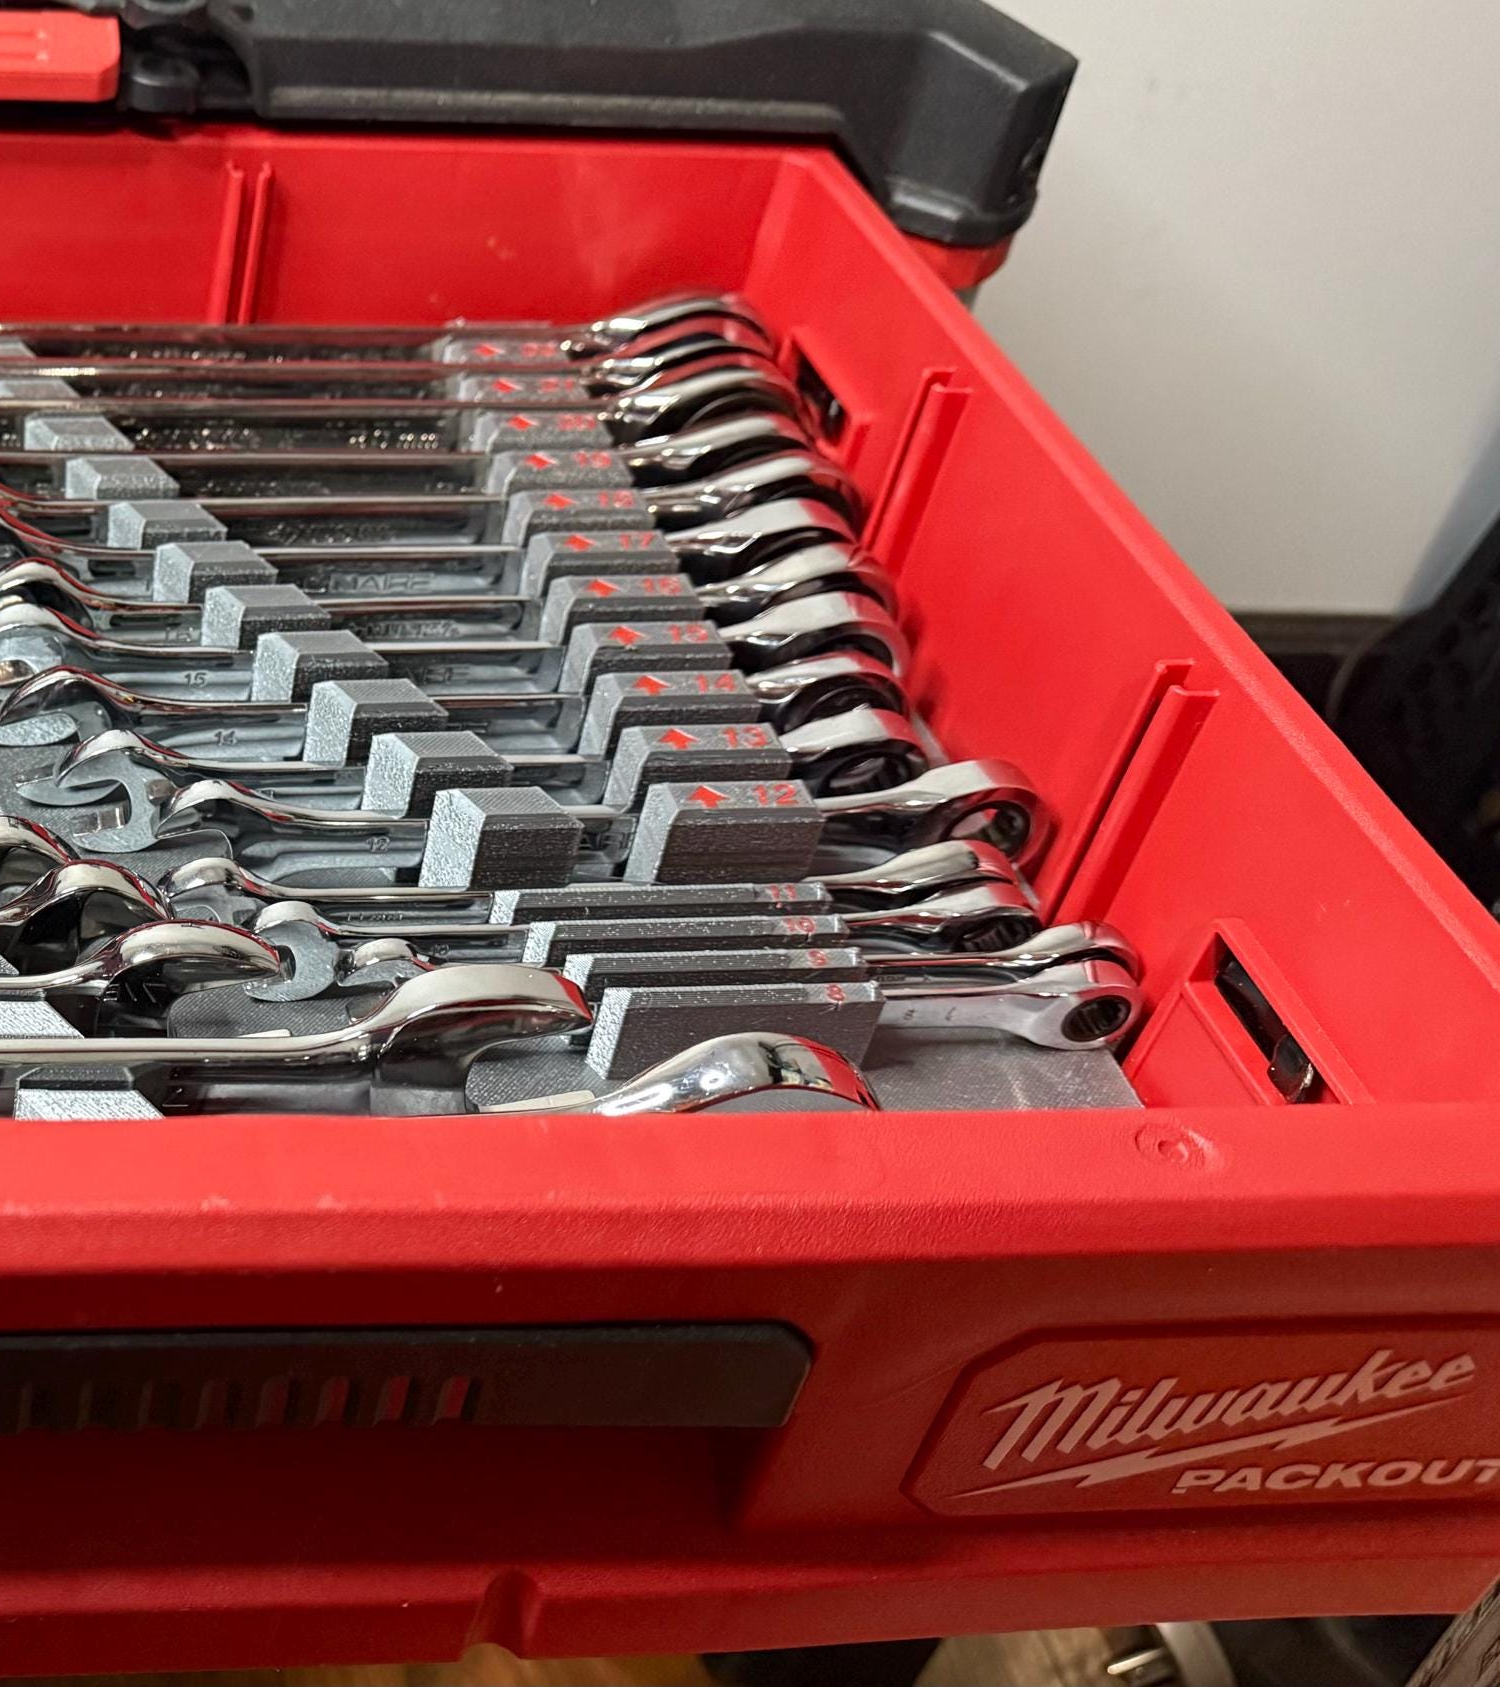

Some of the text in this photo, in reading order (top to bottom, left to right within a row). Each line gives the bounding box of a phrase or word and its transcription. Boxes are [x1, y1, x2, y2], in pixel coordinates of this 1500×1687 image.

[619, 531, 655, 550] 17
[642, 577, 681, 596] 16
[667, 624, 709, 644] 15
[183, 671, 208, 689] 15
[695, 673, 737, 694] 14
[722, 725, 769, 748] 13
[752, 782, 799, 807] 12
[983, 1348, 1477, 1471] Milwaukee
[1171, 1457, 1500, 1495] PACKOUT
